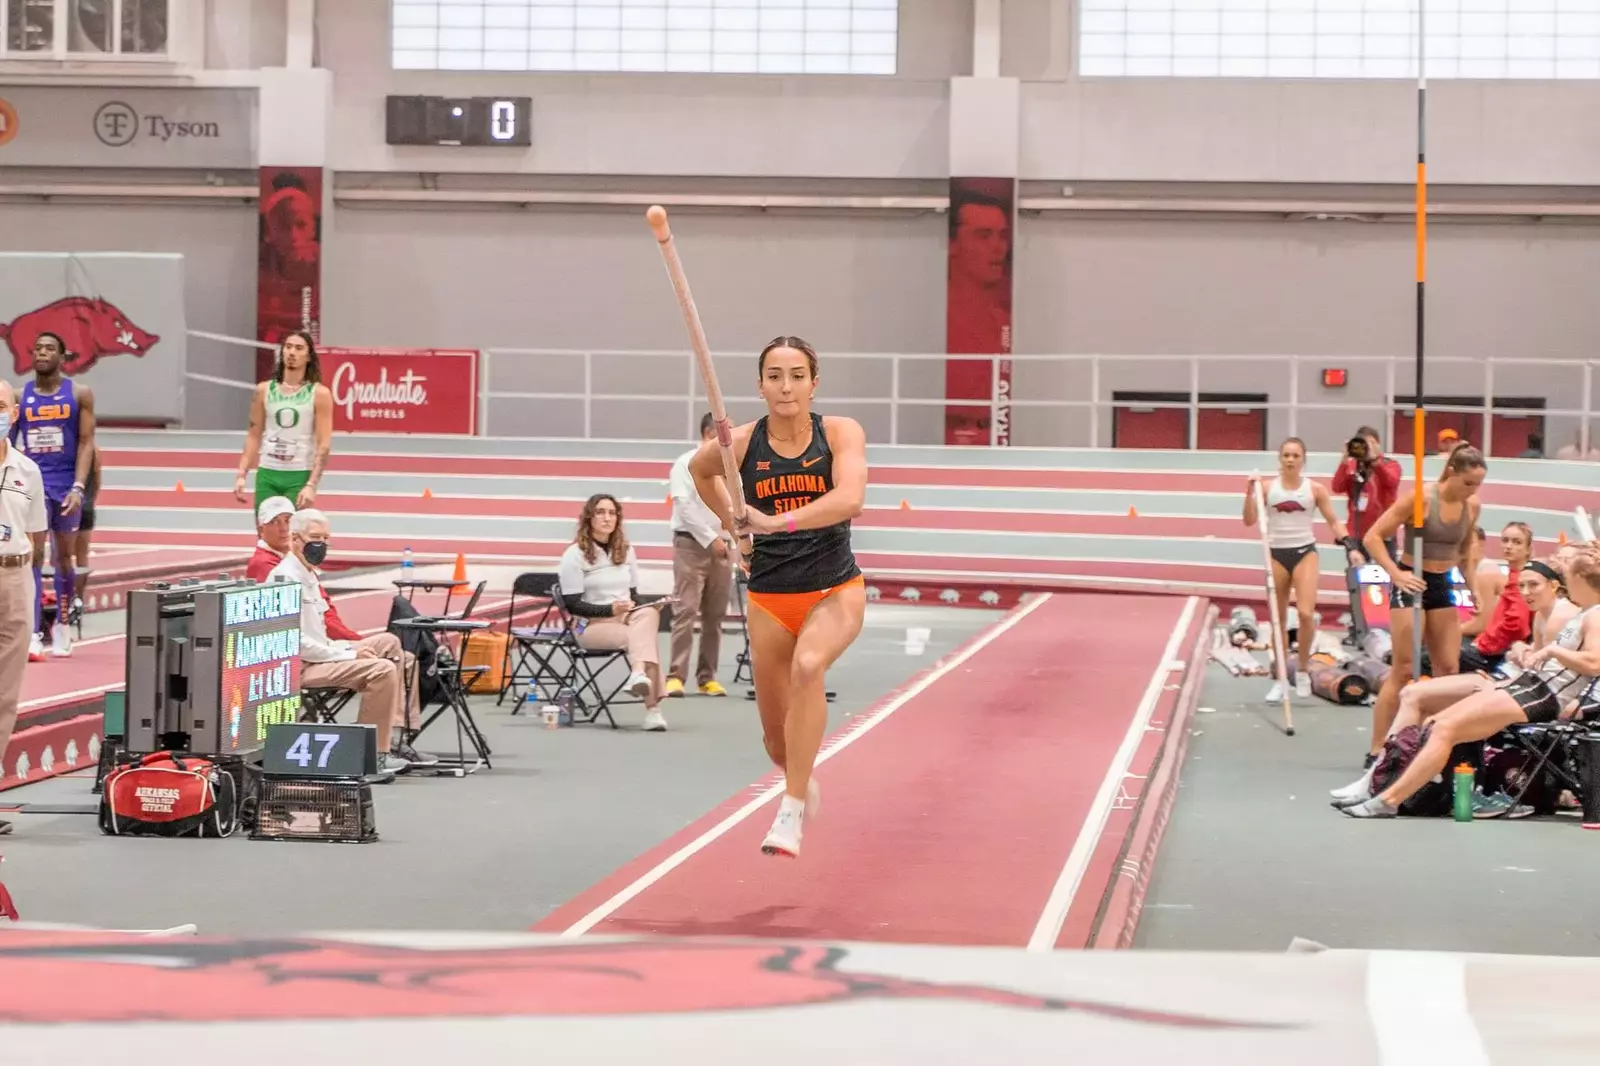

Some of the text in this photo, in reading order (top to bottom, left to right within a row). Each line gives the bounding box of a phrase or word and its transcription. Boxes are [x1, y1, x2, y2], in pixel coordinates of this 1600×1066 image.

[143, 115, 219, 142] Tyson
[331, 361, 427, 421] Graduate
[25, 403, 71, 422] LSU
[275, 407, 300, 429] O
[360, 408, 405, 419] HOTELS
[756, 474, 827, 499] OKLAHOMA
[285, 732, 340, 768] 47
[134, 787, 180, 800] ARKANSAS
[142, 803, 173, 813] OFFICIAL
